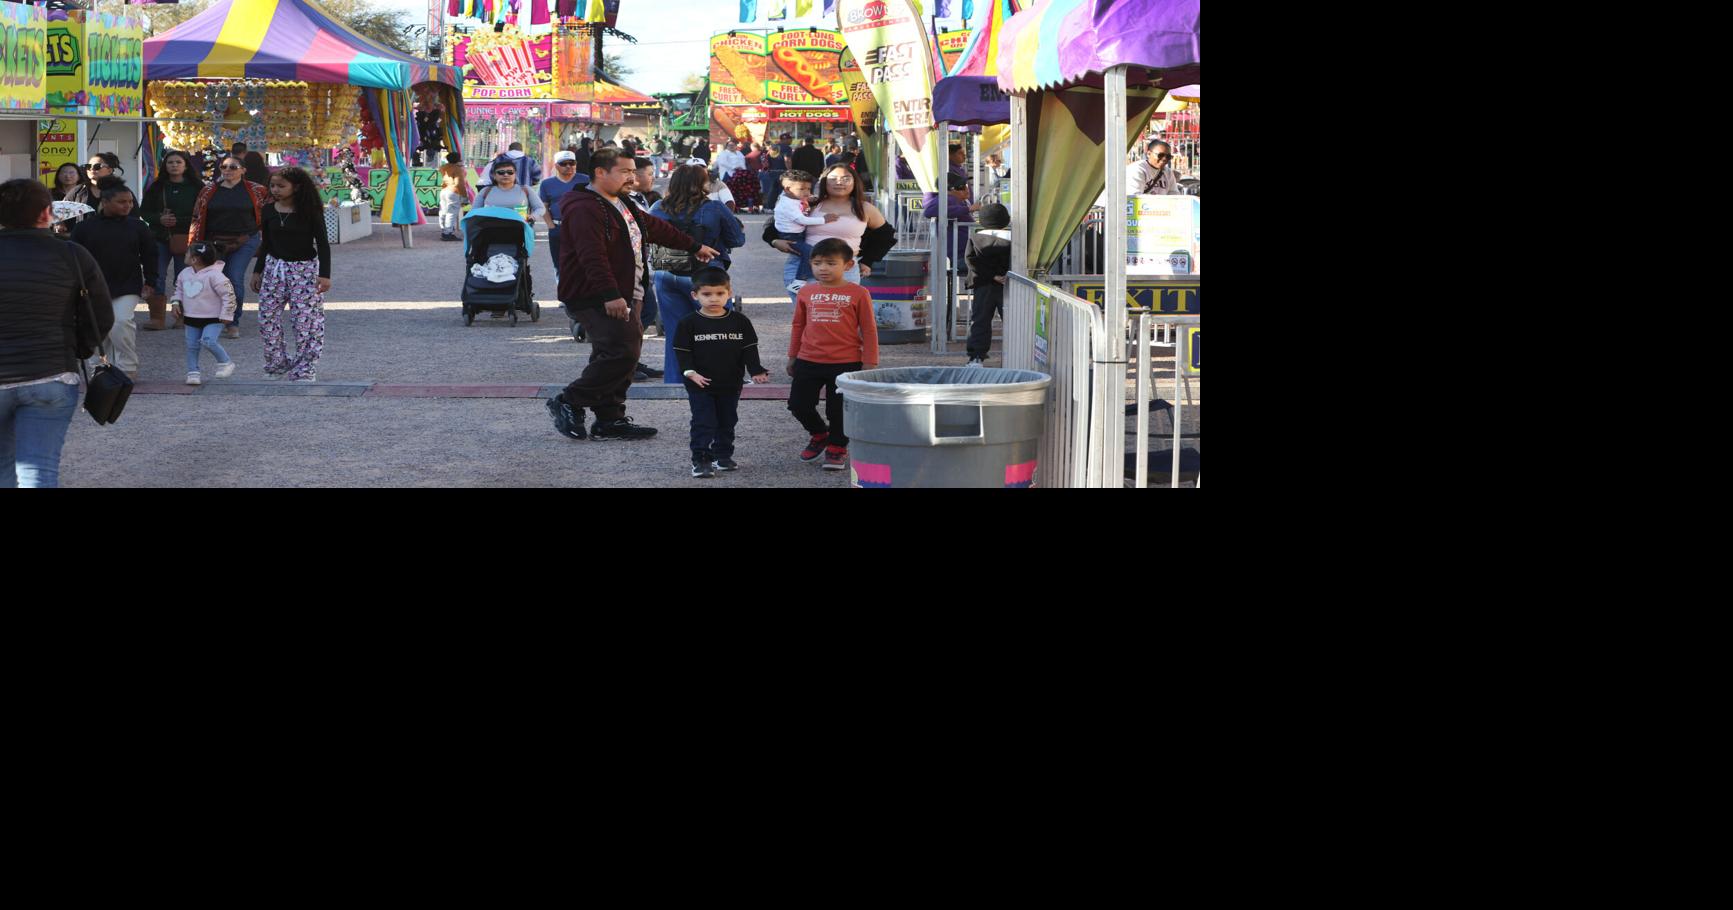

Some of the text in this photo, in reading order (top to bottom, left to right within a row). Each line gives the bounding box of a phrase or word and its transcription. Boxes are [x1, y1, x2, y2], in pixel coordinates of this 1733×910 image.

[849, 5, 888, 22] BROW
[713, 39, 763, 49] CHICKEN
[774, 39, 842, 50] CORN DOGS
[88, 32, 141, 89] TICKETS
[472, 88, 532, 97] POP CORN
[781, 84, 805, 94] FRES
[772, 90, 808, 102] CURLY
[810, 293, 851, 302] LET'S RIDE
[694, 333, 727, 341] KENNETH
